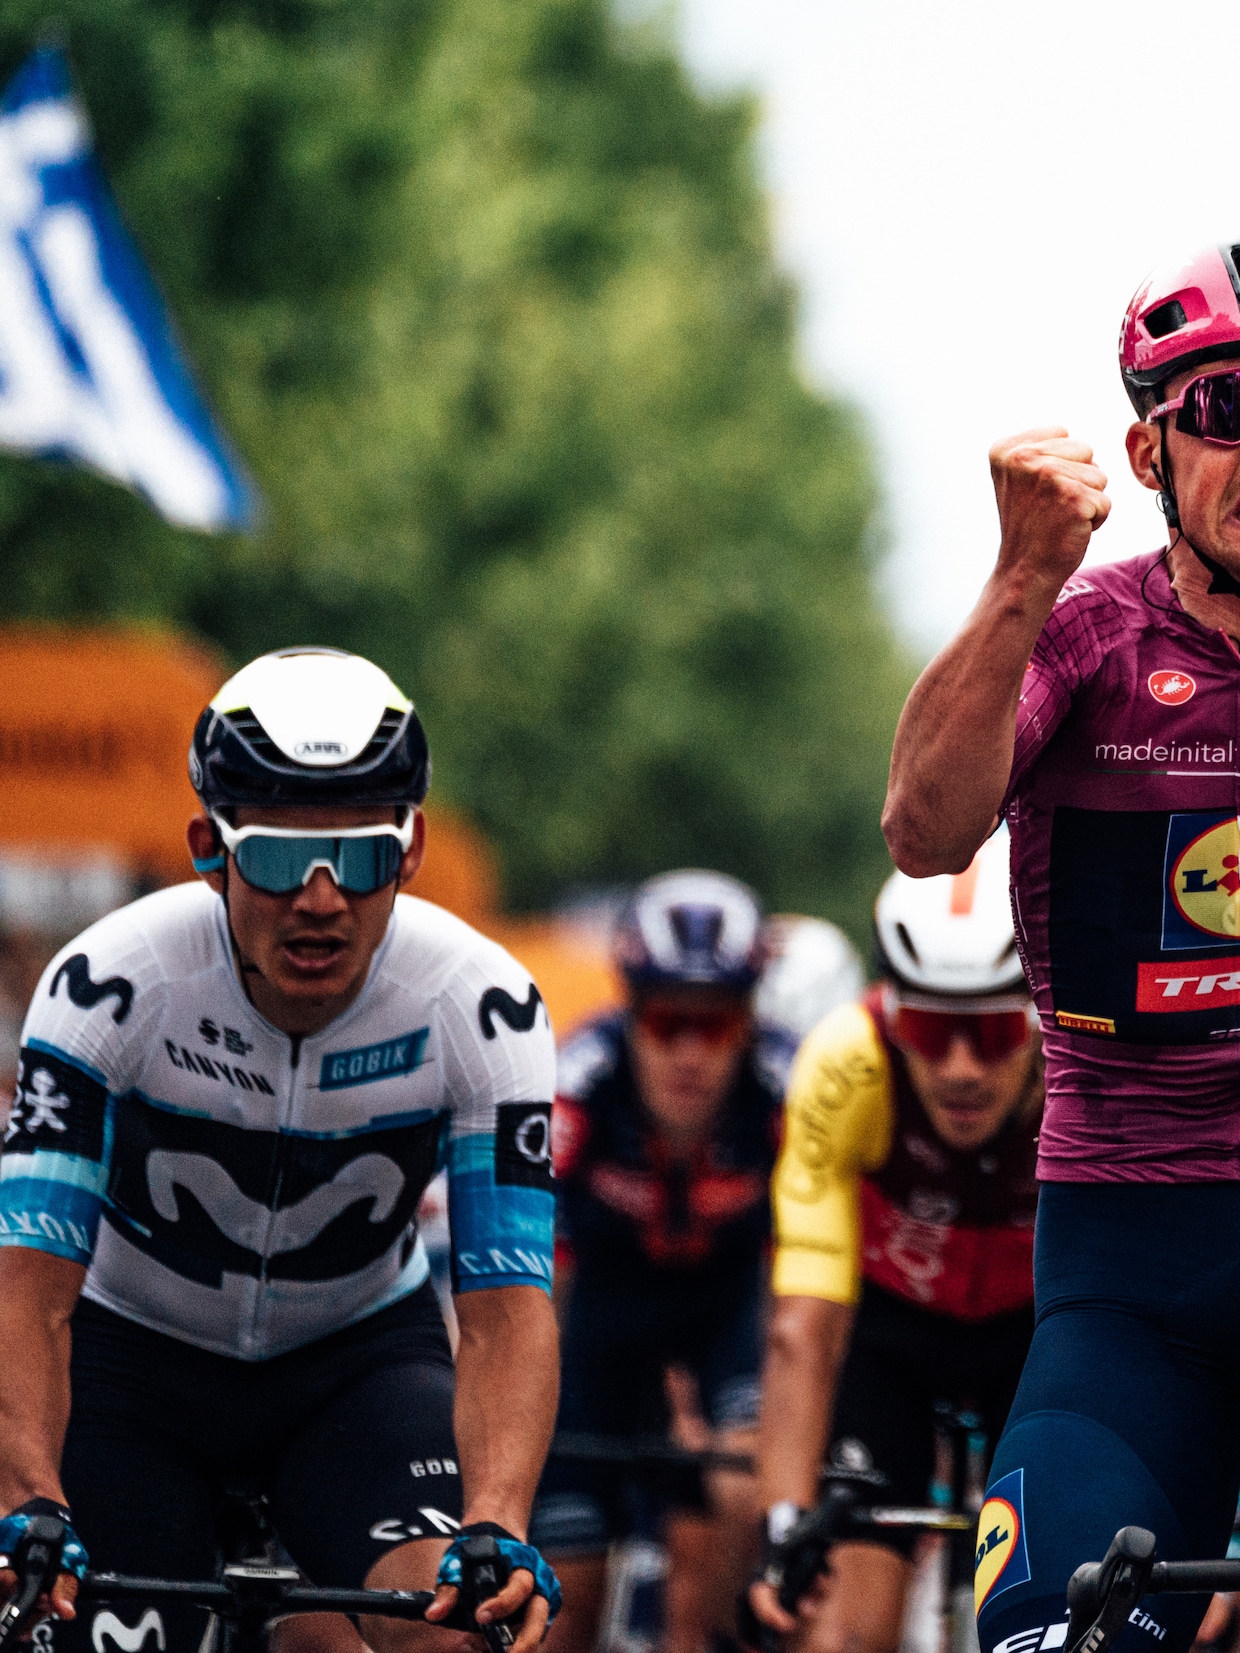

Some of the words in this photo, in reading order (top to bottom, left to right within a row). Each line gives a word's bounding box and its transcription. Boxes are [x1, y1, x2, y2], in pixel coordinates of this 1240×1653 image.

[164, 1039, 275, 1097] CANYON
[331, 1041, 408, 1080] GOBIK
[409, 1458, 458, 1477] GOB
[1127, 1607, 1168, 1642] tini
